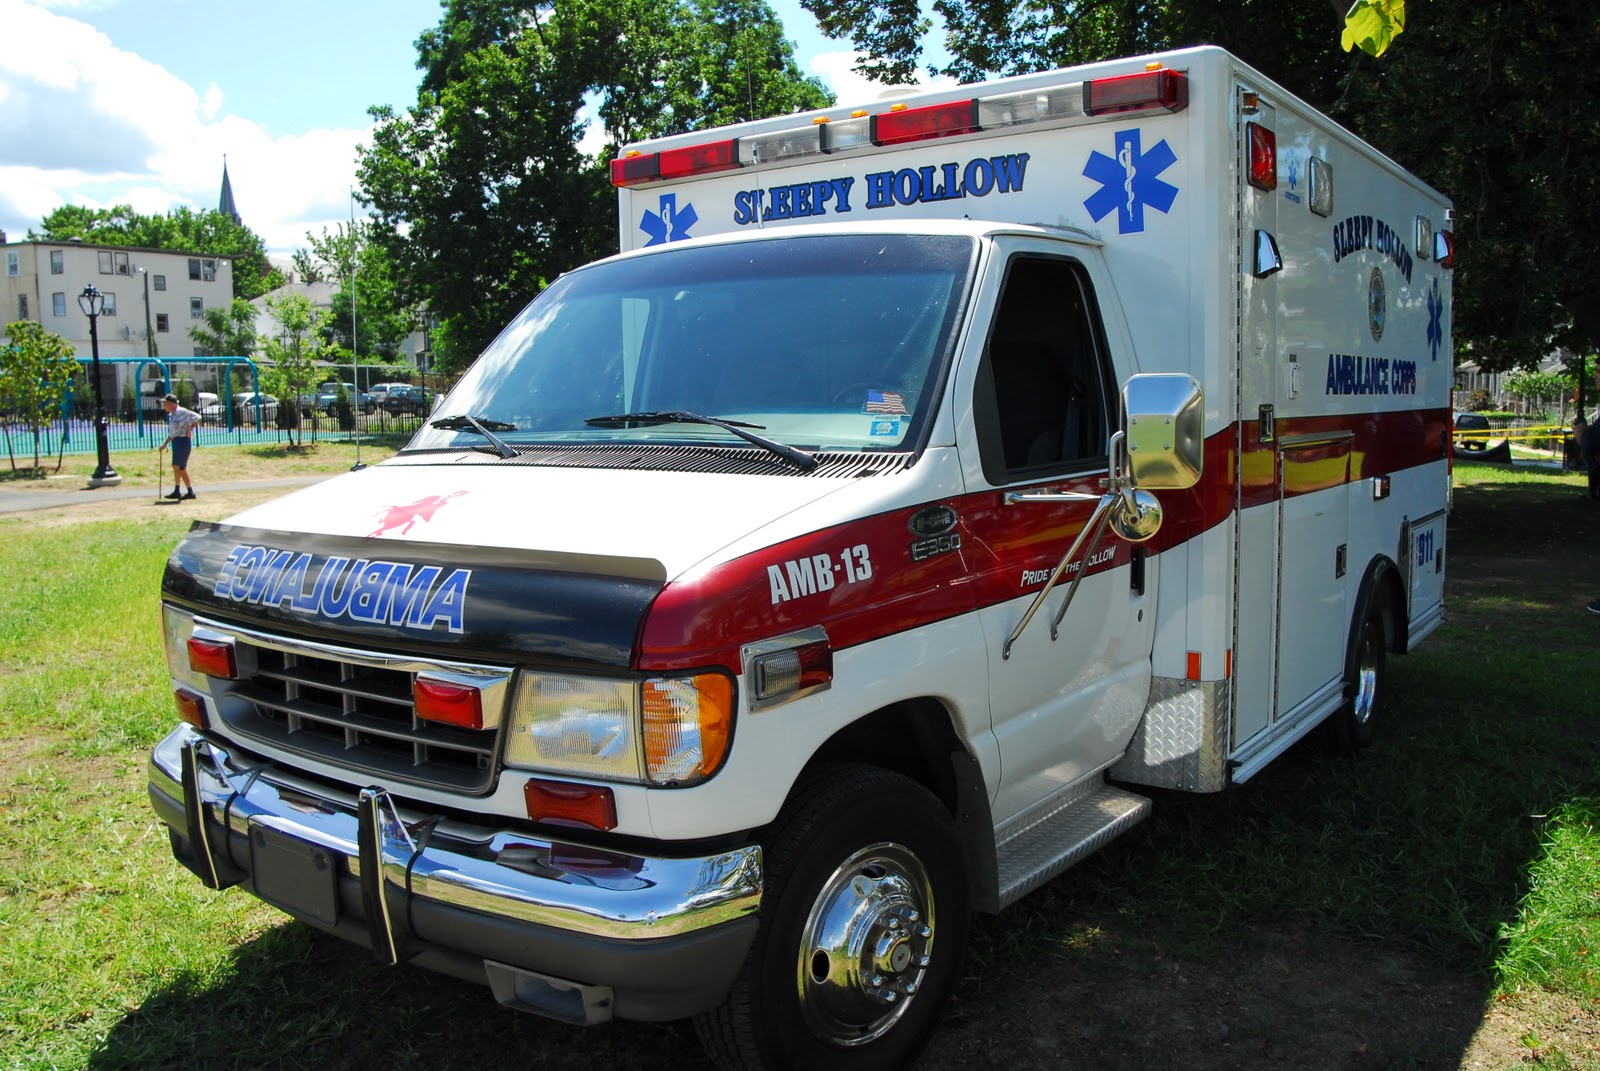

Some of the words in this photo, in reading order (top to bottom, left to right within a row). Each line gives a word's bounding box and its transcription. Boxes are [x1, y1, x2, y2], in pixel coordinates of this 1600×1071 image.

[734, 176, 855, 225] SLEEPY
[865, 152, 1030, 210] HOLLOW
[1333, 215, 1373, 263] SLEEPY
[1376, 218, 1413, 285] HOLLOW
[1326, 353, 1389, 395] AMBULANCE
[1391, 358, 1416, 395] CORPS
[911, 533, 961, 561] E350
[1020, 569, 1049, 587] PRIDE
[1065, 560, 1081, 574] THE
[1088, 544, 1116, 567] OLLOW
[1418, 528, 1433, 567] 911
